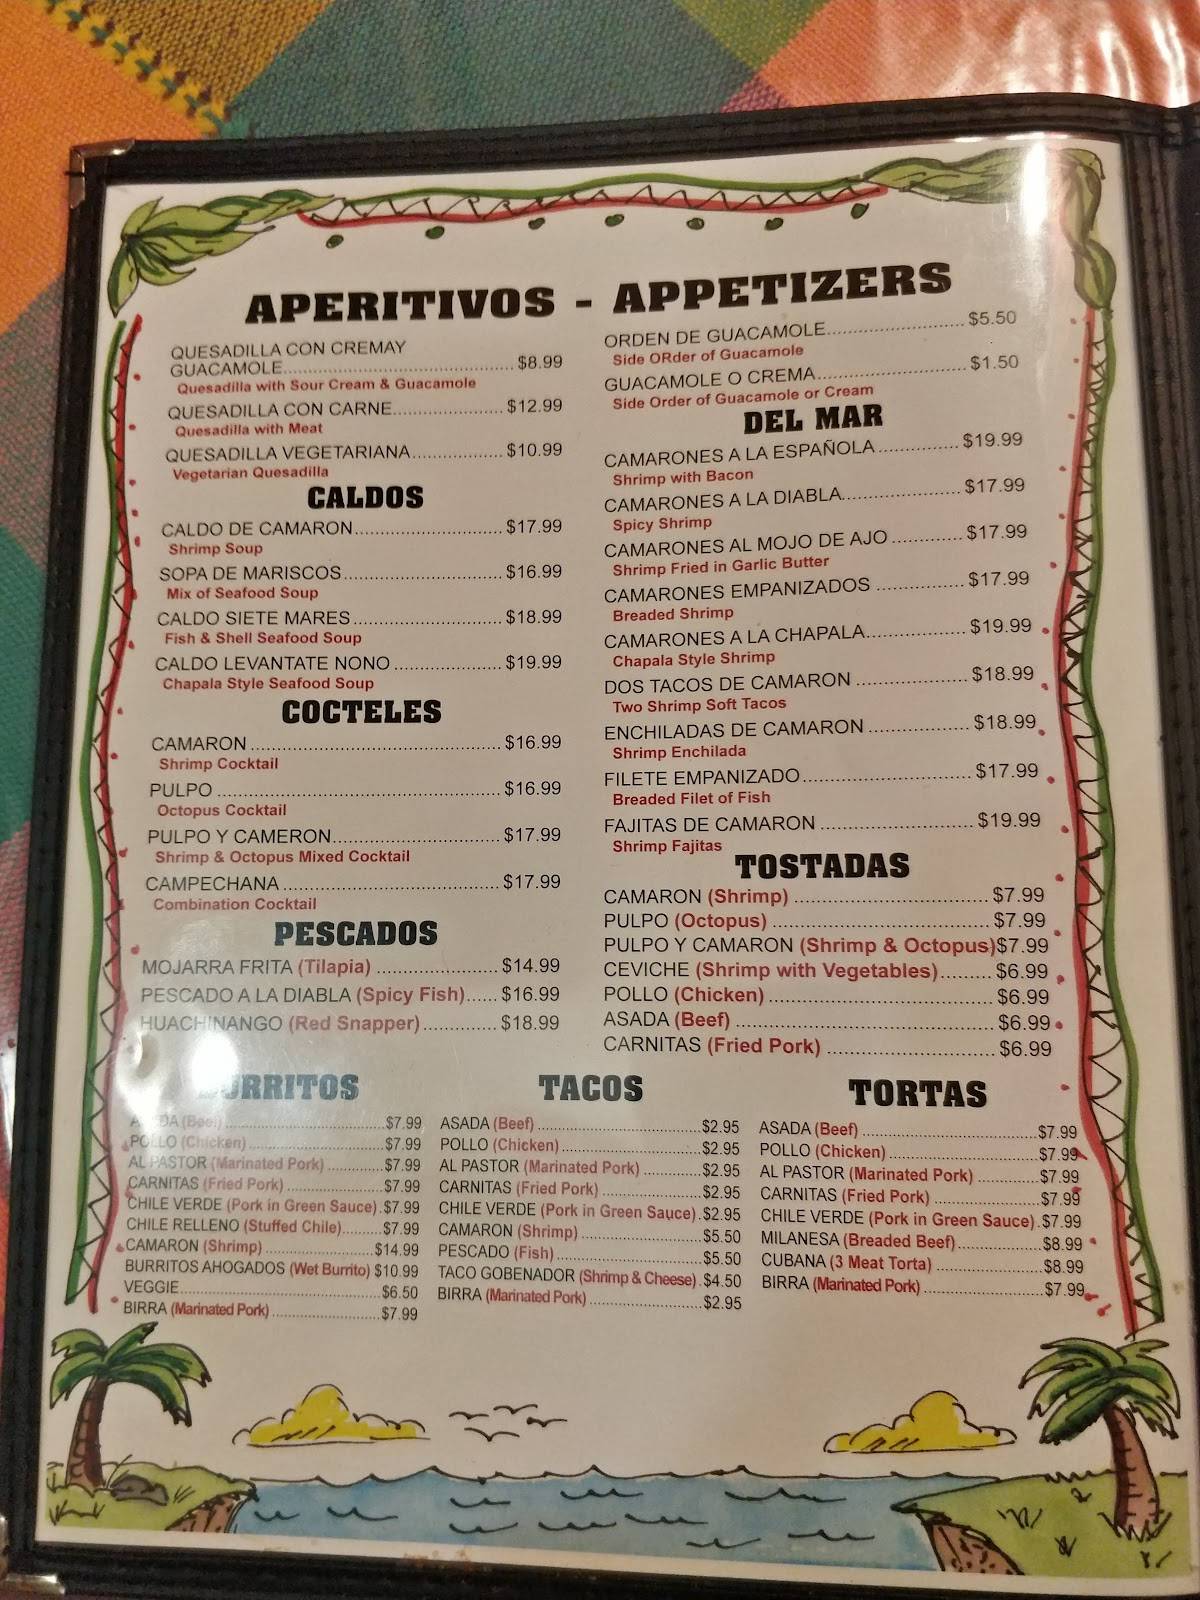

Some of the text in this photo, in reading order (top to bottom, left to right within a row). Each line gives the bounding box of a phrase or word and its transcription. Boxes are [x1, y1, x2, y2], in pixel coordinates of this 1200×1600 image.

[245, 262, 951, 323] APERITIVOS - APPETIZERS
[604, 310, 1016, 347] ORDEN DE GUACAMOLE $5.50
[170, 355, 562, 377] GUACAMOLE $8.99
[604, 354, 1018, 391] GUACAMOLE O CREMA $1.50
[177, 377, 475, 394] Quesadilla with Sour Cream & Guacamole
[168, 398, 562, 420] QUESADILLA CON CARNE $12.99
[744, 404, 882, 434] DEL MAR
[165, 442, 561, 462] QUESADILLA VEGETARIANA $10.99
[307, 485, 423, 509] CALDOS
[604, 477, 1024, 512] CAMARONES A LA DIABLA $17.99
[161, 519, 561, 537] CALDO DE CAMARON $17.99
[613, 516, 712, 533] Spicy Shrimp
[159, 564, 561, 581] SOPA DE MARISCOS $16.99
[167, 586, 318, 600] Mix of Seafood Soup
[604, 571, 1029, 603] CAMARONES EMPANIZADOS $17.99
[157, 609, 561, 626] CALDO SIETE MARES $18.99
[613, 607, 733, 621] Breaded Shrimp
[165, 631, 361, 646] Fish & Shell Seafood Soup
[605, 666, 1033, 694] DOS TACOS DE CAMARON $18.99
[282, 699, 441, 723] COCTELES
[612, 697, 786, 714] Two Shrimp Soft Tacos
[152, 734, 561, 750] CAMARON $16.99
[159, 757, 277, 772] Shrimp Cocktail
[605, 763, 1038, 786] FILETE EMPANIZADO $17.99
[150, 780, 560, 797] PULPO $16.99
[157, 803, 286, 818] Octopus Cocktail
[605, 812, 1040, 832] FAJITAS DE CAMARON $19.99
[735, 852, 909, 878] TOSTADAS
[145, 873, 560, 891] CAMPECHANA $17.99
[604, 886, 1044, 907] CAMARON (Shrimp) $7.99
[604, 912, 1045, 931] PULPO (Octopus) $7.99
[274, 920, 437, 946] PESCADOS
[142, 957, 559, 977] MOJARRA FRITA (Tilapia) $14.99
[141, 985, 559, 1005] PESCADO A LA DIABLA (Spicy Fish) $16.99
[604, 986, 1048, 1005] POLLO (Chicken) $6.99
[603, 1011, 1050, 1031] ASADA (Beef) $6.99
[538, 1074, 642, 1101] TACOS
[848, 1079, 986, 1107] TORTAS
[440, 1116, 739, 1133] ASADA (Beef) $2.95
[759, 1121, 1077, 1139] ASADA (Beef) $7.99
[441, 1137, 739, 1155] POLLO (Chicken) $2.95
[127, 1217, 419, 1236] CHILE RELLENO (Stuffed Chile) $7.99
[439, 1222, 740, 1243] CAMARON (Shrimp) $5.50
[126, 1238, 418, 1256] CAMARON (Shrimp) $14.99
[761, 1230, 1082, 1251] MILANESA (Breaded Beef) $8.99
[439, 1243, 740, 1266] PESCADO (Fish) $5.50
[761, 1252, 1083, 1274] CUBANA (3 Meat Torta) $8.99
[124, 1280, 417, 1299] VEGGIE $6.50
